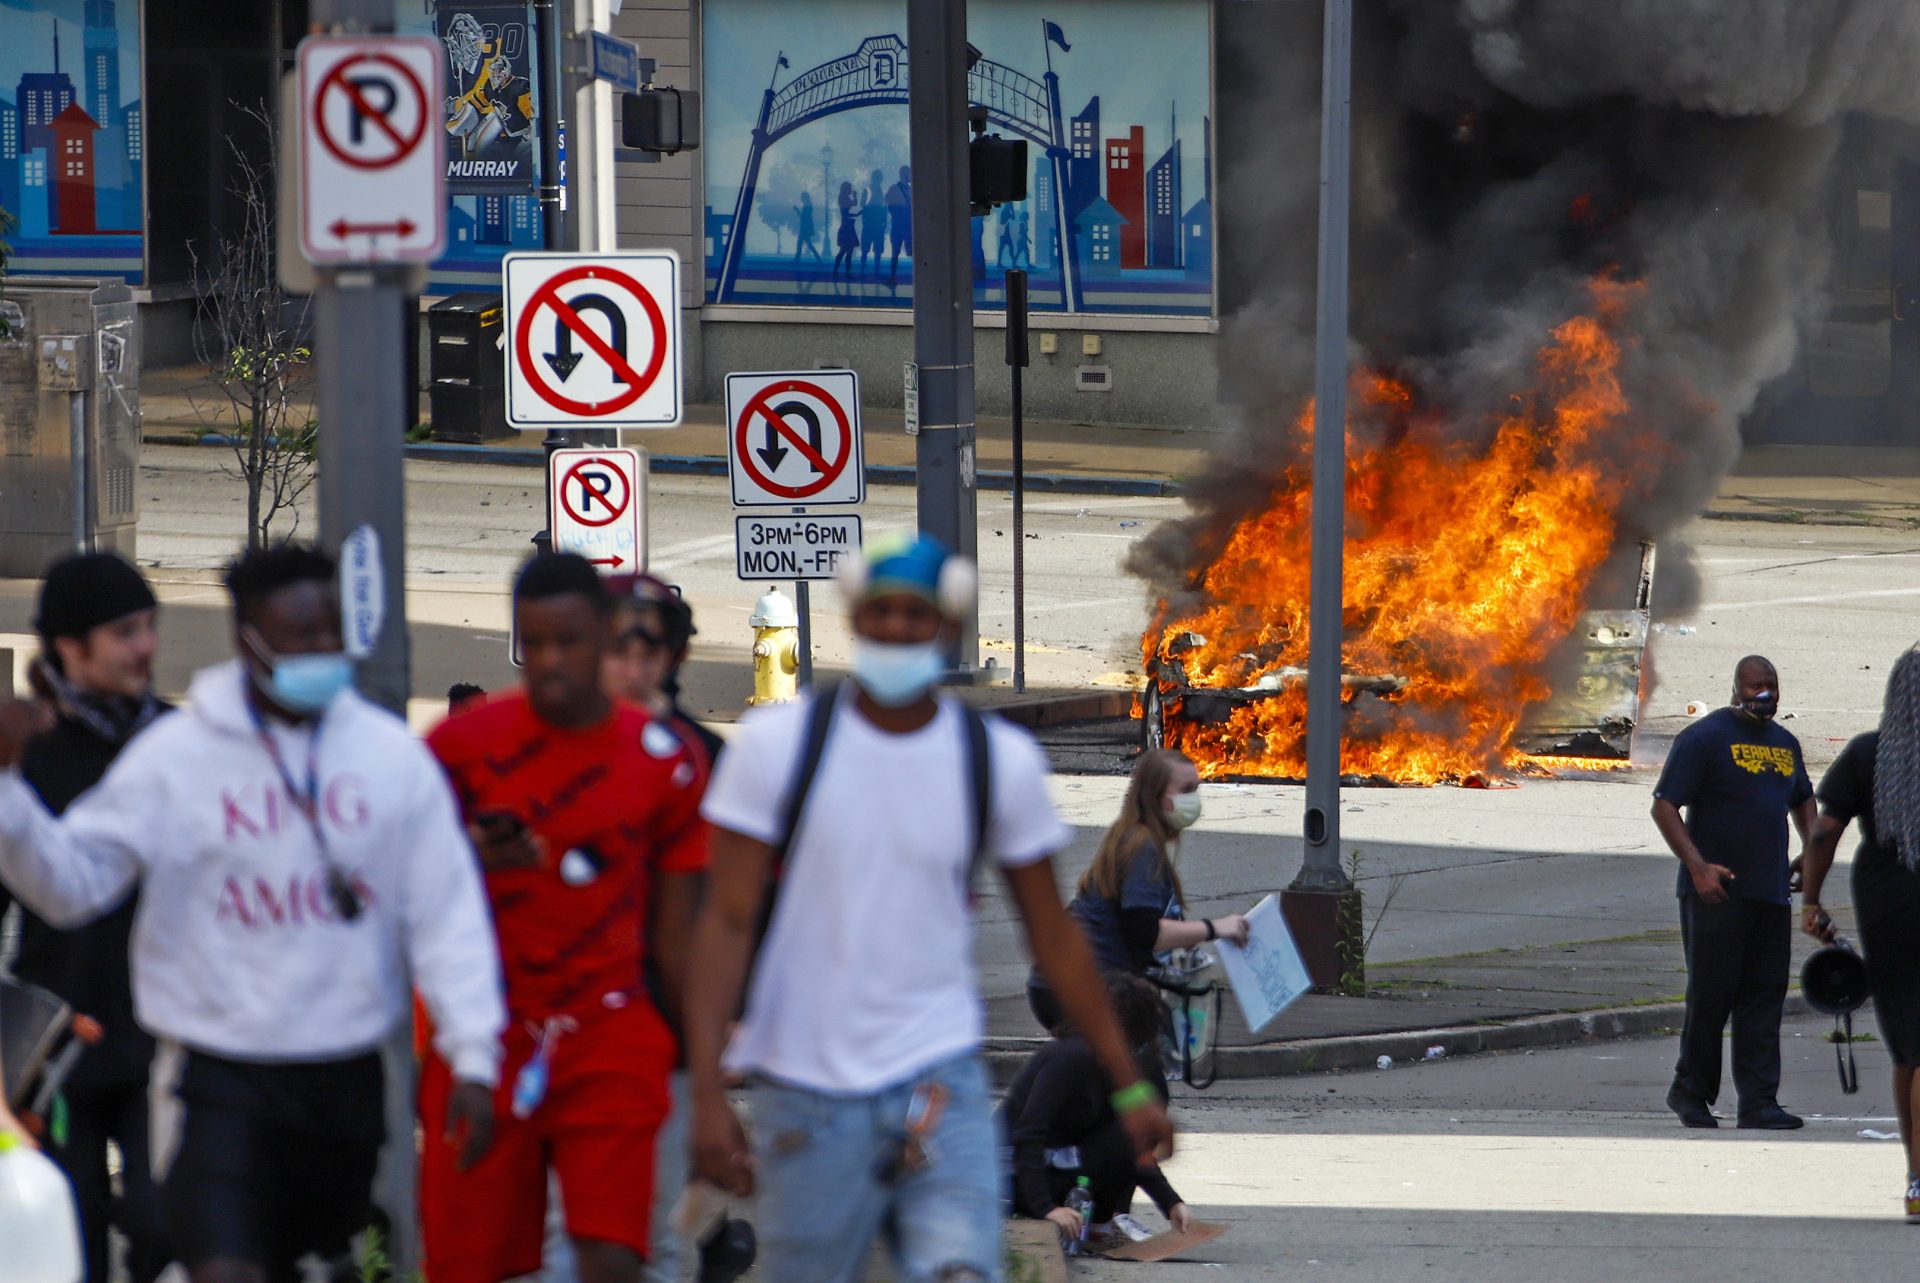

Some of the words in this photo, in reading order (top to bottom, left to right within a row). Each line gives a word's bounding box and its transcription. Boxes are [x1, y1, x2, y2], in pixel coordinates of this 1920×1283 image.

[873, 54, 895, 85] D
[447, 160, 518, 177] MURRAY
[750, 522, 847, 545] 3PM-6PM
[1730, 744, 1793, 764] FEARLESS
[220, 772, 370, 841] KIG
